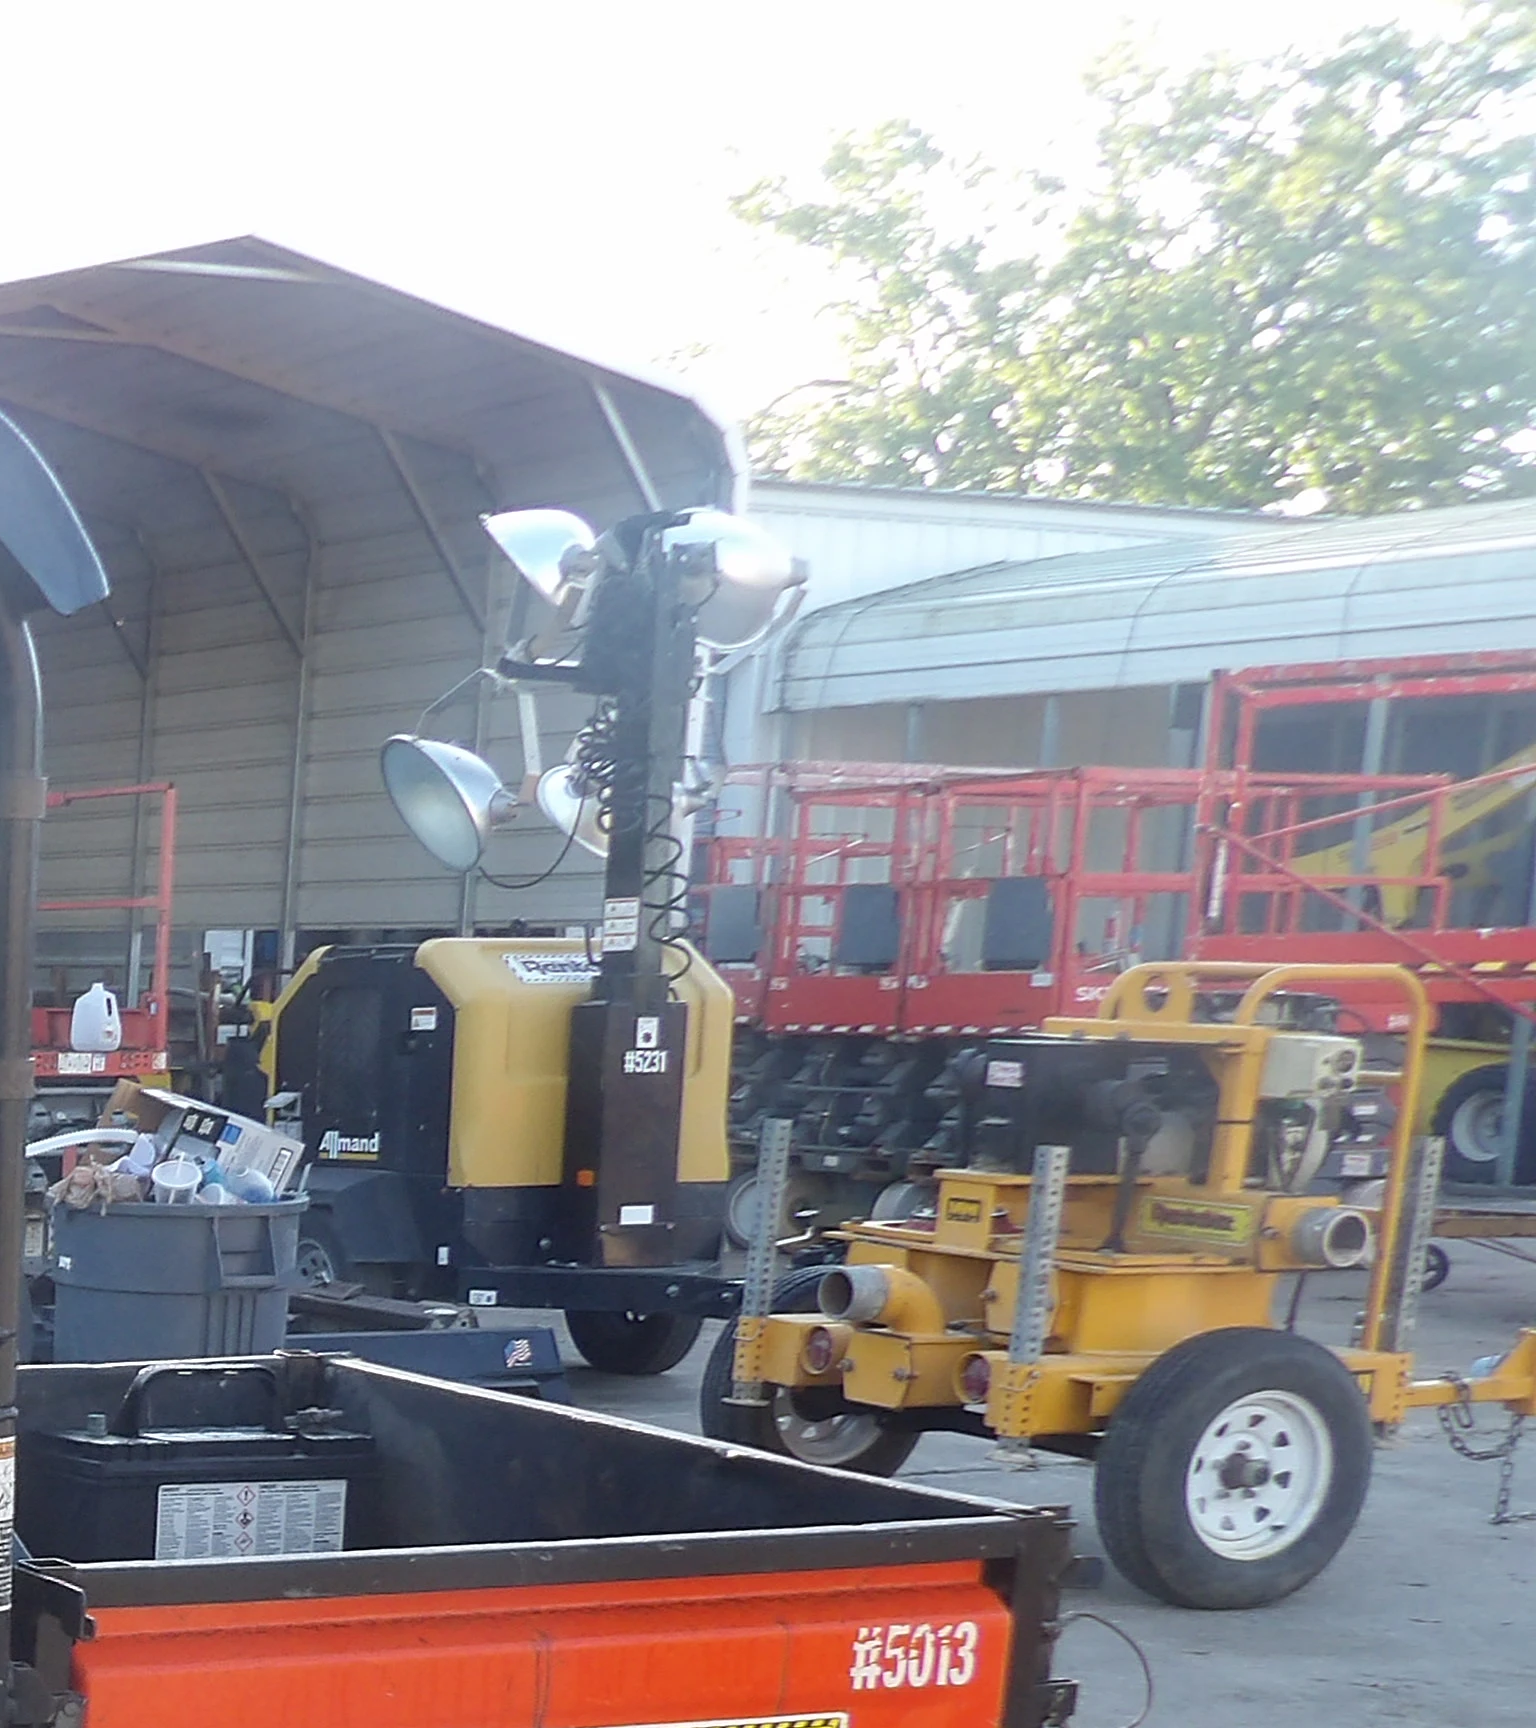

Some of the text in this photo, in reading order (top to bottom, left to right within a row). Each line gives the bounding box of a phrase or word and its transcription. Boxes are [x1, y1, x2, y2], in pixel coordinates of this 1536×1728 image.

[623, 1050, 668, 1073] #5231
[319, 1130, 380, 1159] Allmand
[849, 1620, 978, 1690] #5013
